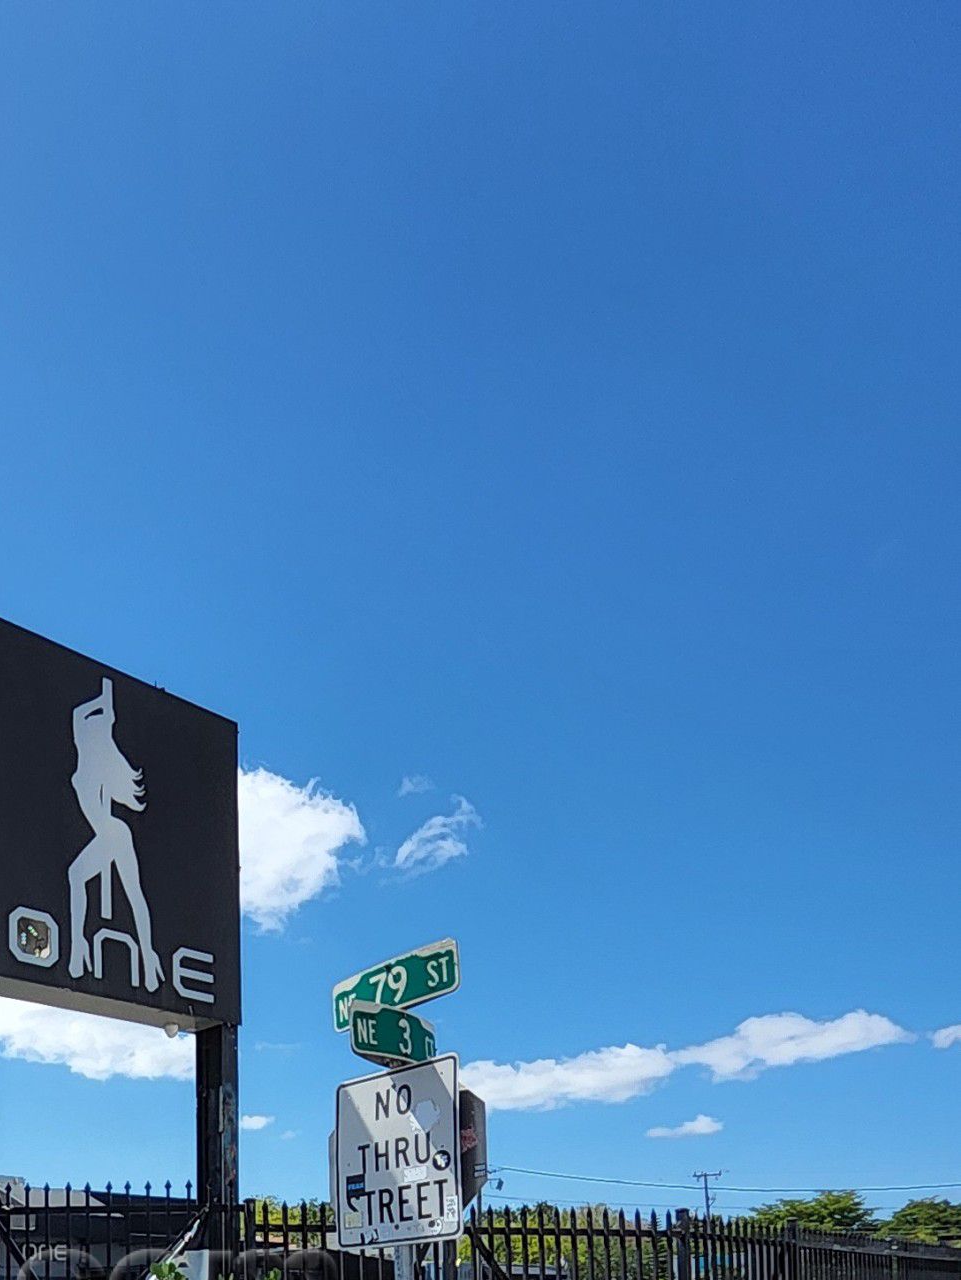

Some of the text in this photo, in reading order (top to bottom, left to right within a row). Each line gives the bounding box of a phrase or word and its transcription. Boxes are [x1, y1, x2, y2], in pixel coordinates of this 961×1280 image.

[369, 966, 407, 1004] 79
[427, 957, 449, 988] ST
[357, 1018, 378, 1045] NE
[398, 1019, 413, 1055] 3
[375, 1084, 412, 1121] NO
[358, 1131, 431, 1174] THRU
